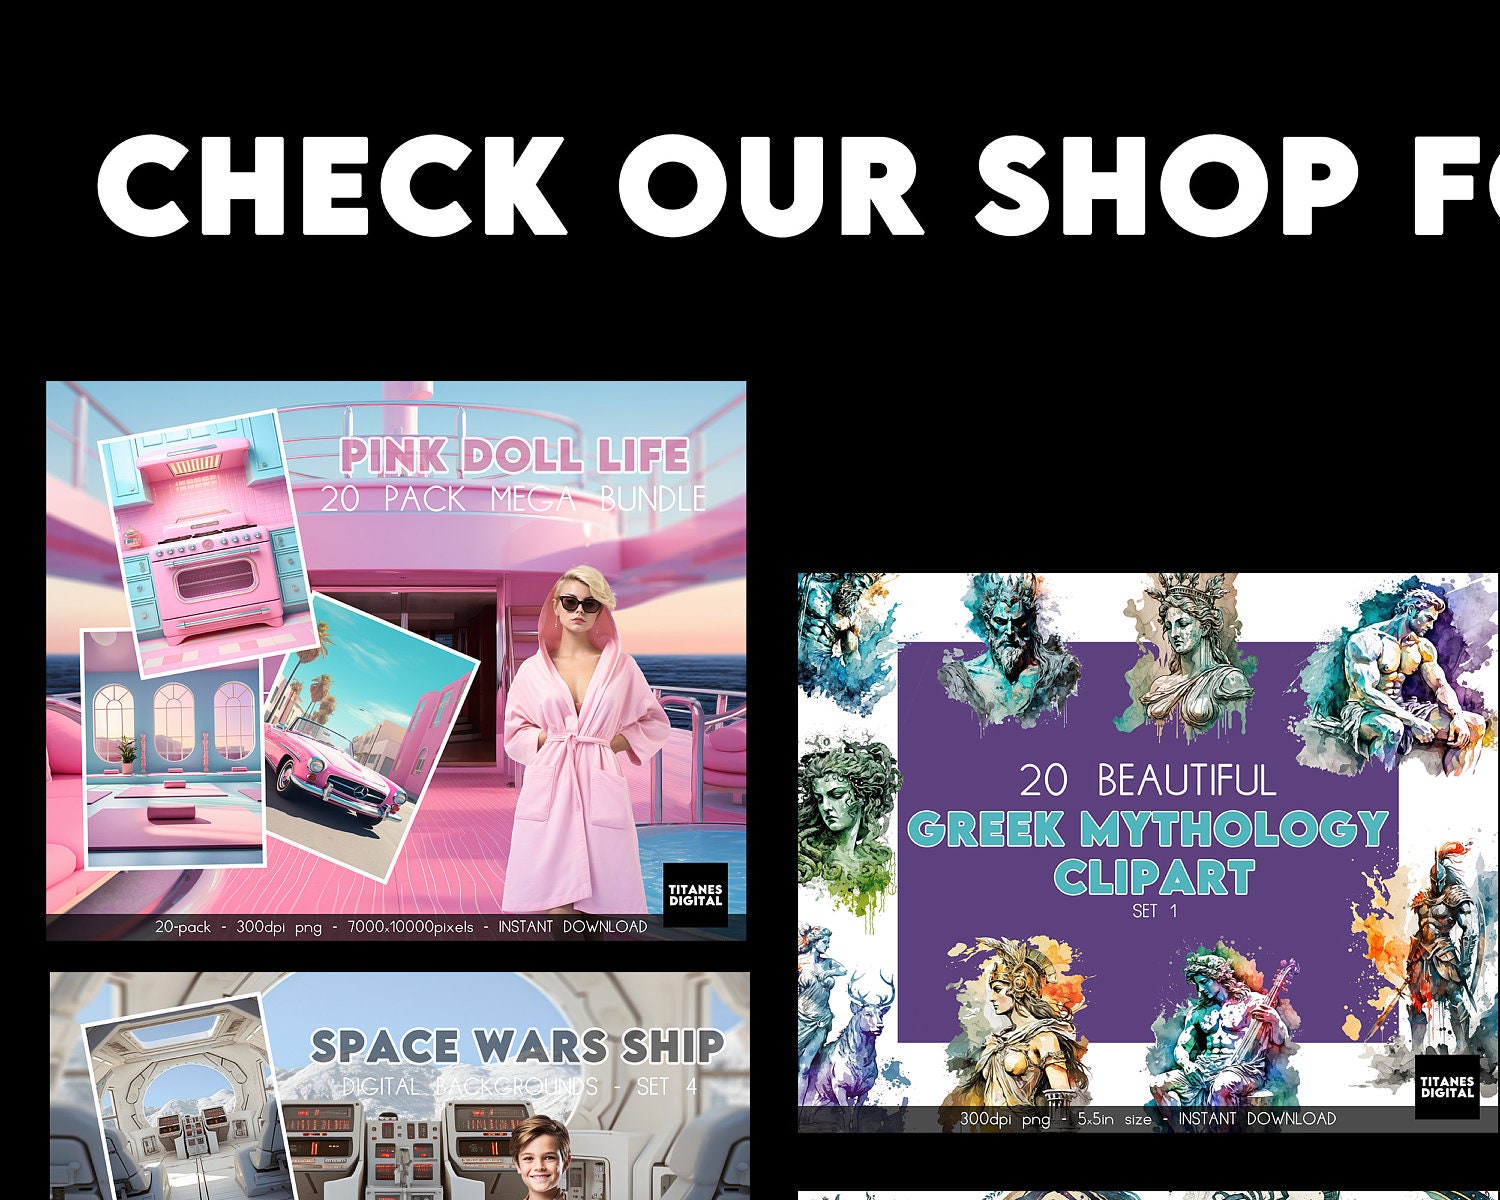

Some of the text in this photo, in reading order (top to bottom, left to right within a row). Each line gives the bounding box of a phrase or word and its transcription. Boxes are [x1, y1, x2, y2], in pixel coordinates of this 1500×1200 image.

[98, 134, 568, 237] CHECK
[619, 134, 925, 238] OUR
[975, 134, 1358, 237] SHOP
[340, 435, 690, 477] PINK DOLL LIFE
[321, 484, 706, 513] 20 PACK MEGA BUNDLE
[1020, 762, 1277, 796] 20 BEAUTIFUL
[908, 809, 1389, 848] GREEK MYTHOLOGY
[1053, 857, 1256, 896] CLIPART
[668, 884, 723, 895] TITANES
[669, 895, 724, 906] DIGITAL
[1133, 903, 1177, 918] SET 1
[155, 919, 212, 937] 20-pack
[236, 919, 285, 937] 300dpi
[295, 924, 322, 937] png
[499, 919, 554, 933] INSTANT
[563, 919, 648, 934] DOWNLOAD
[309, 1027, 725, 1066] SPACE WARS SHIP
[343, 1077, 698, 1096] DIGITAL BACKGROUNDS SET 4
[1420, 1076, 1475, 1087] TITANES
[1421, 1087, 1476, 1098] DIGITAL
[960, 1111, 1012, 1130] 300dpi
[1022, 1115, 1051, 1130] png
[1124, 1114, 1153, 1126] size
[1179, 1111, 1237, 1126] INSTANT
[1247, 1111, 1337, 1126] DOWNLOAD
